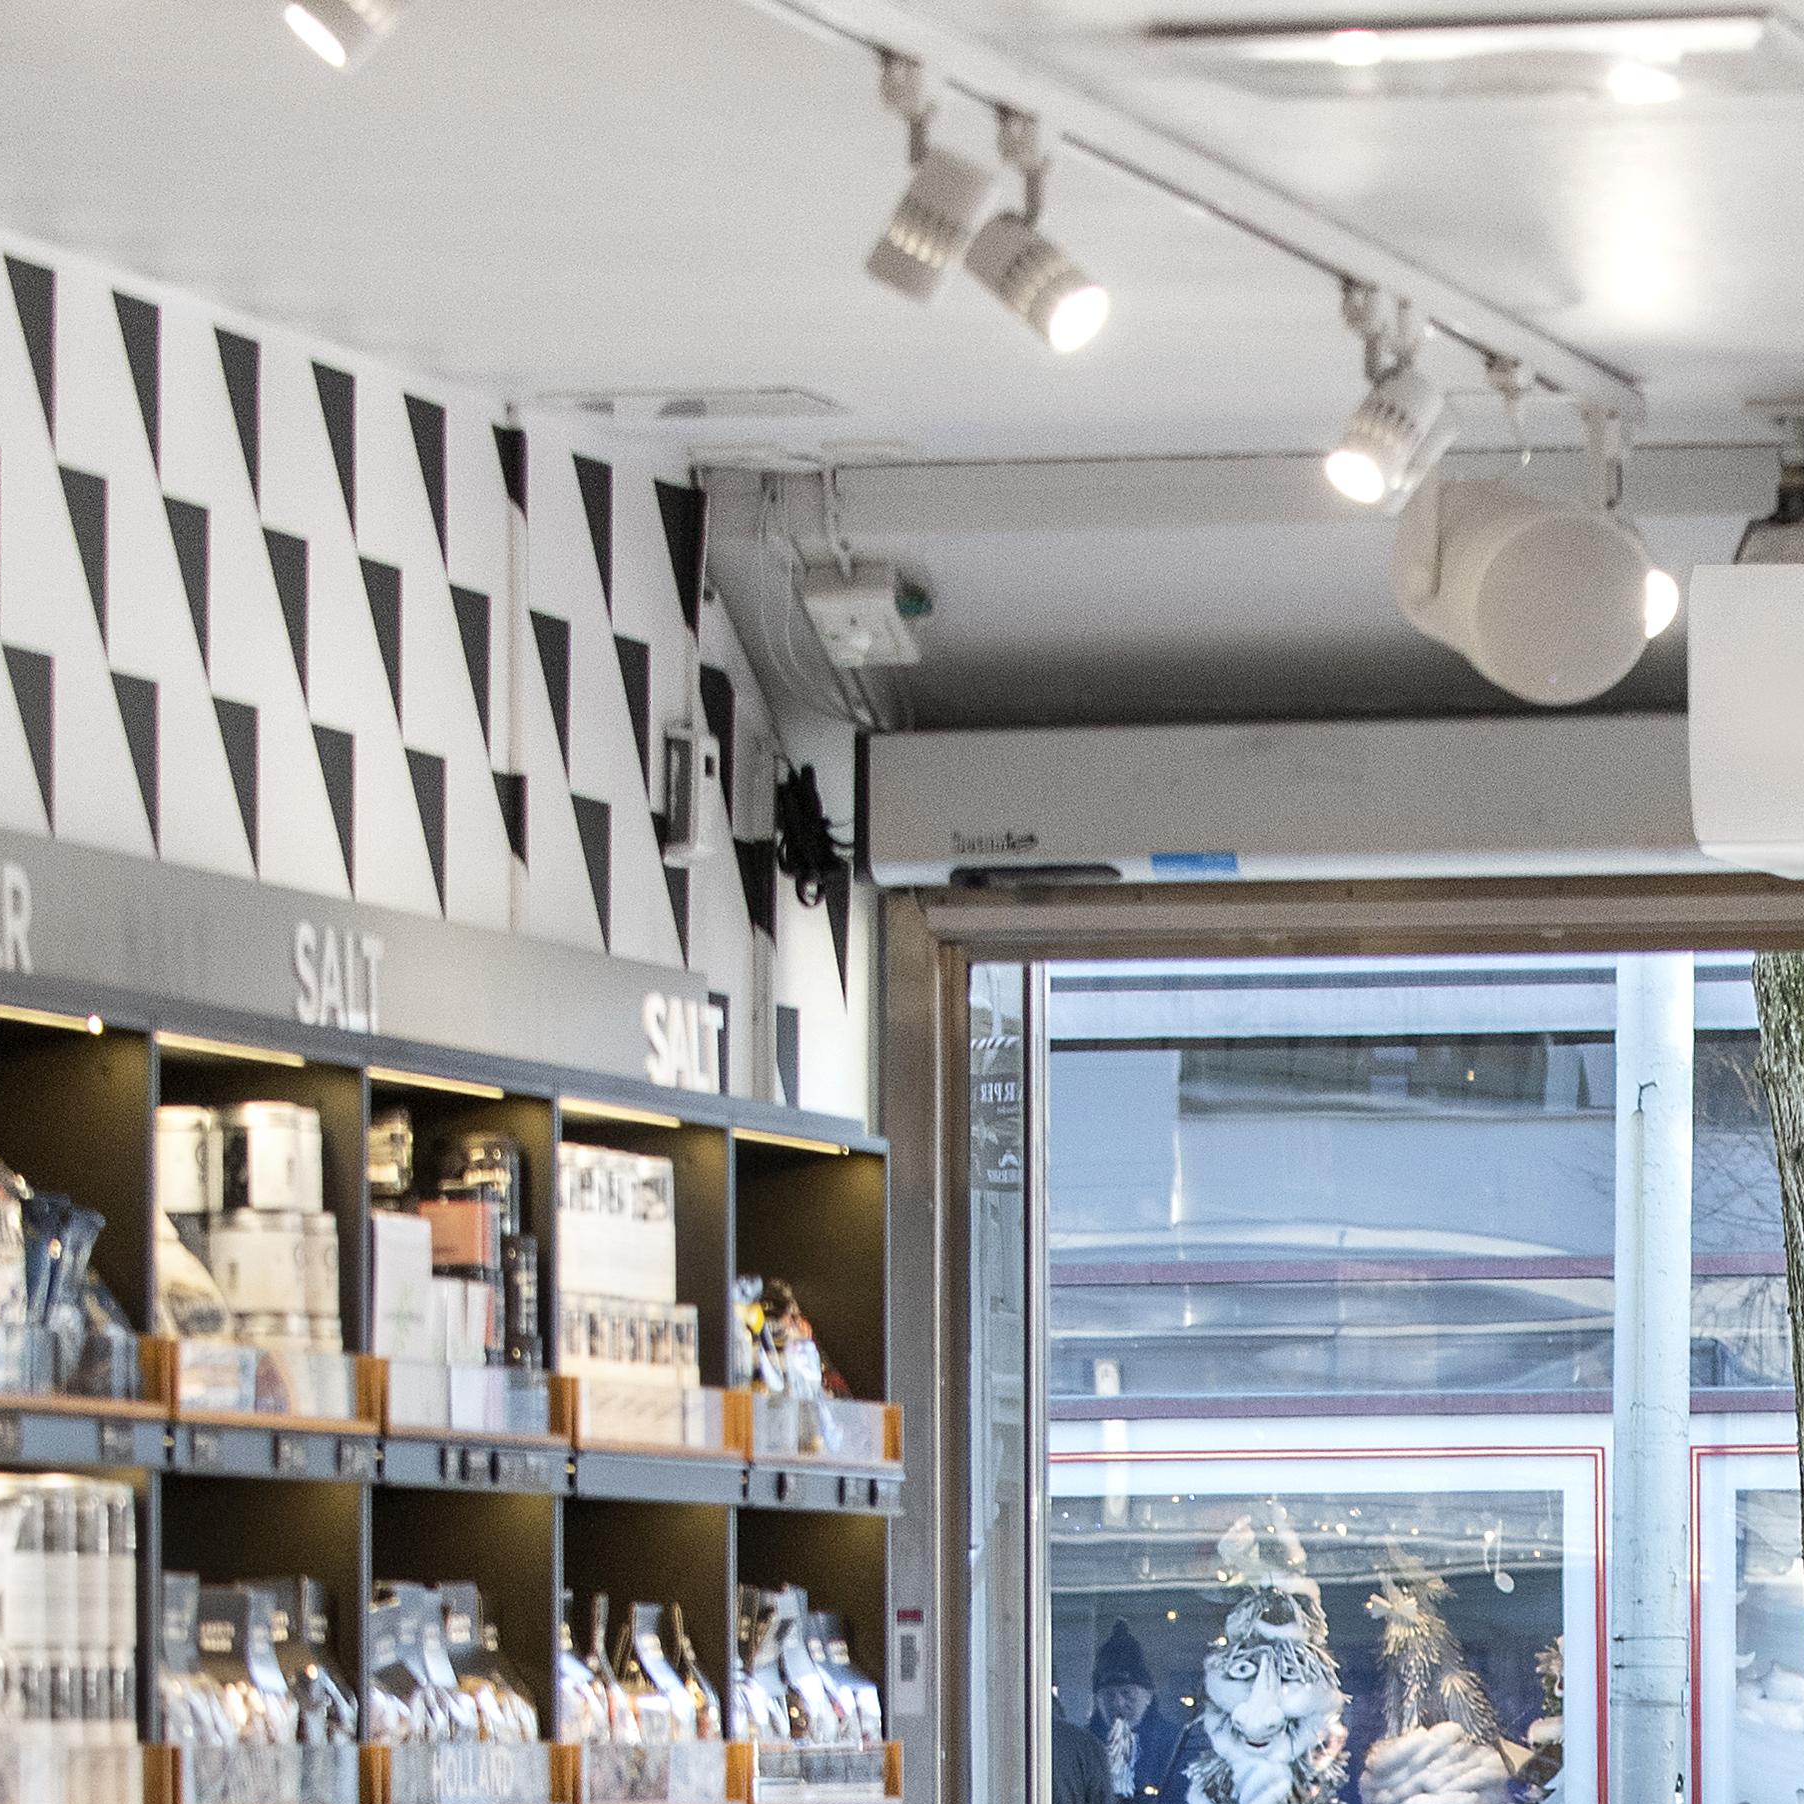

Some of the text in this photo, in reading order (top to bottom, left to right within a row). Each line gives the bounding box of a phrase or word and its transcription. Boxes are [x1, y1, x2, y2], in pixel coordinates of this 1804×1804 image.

[294, 921, 384, 1036] SALT
[642, 991, 724, 1095] SALT
[431, 1745, 515, 1800] HOLLAND
